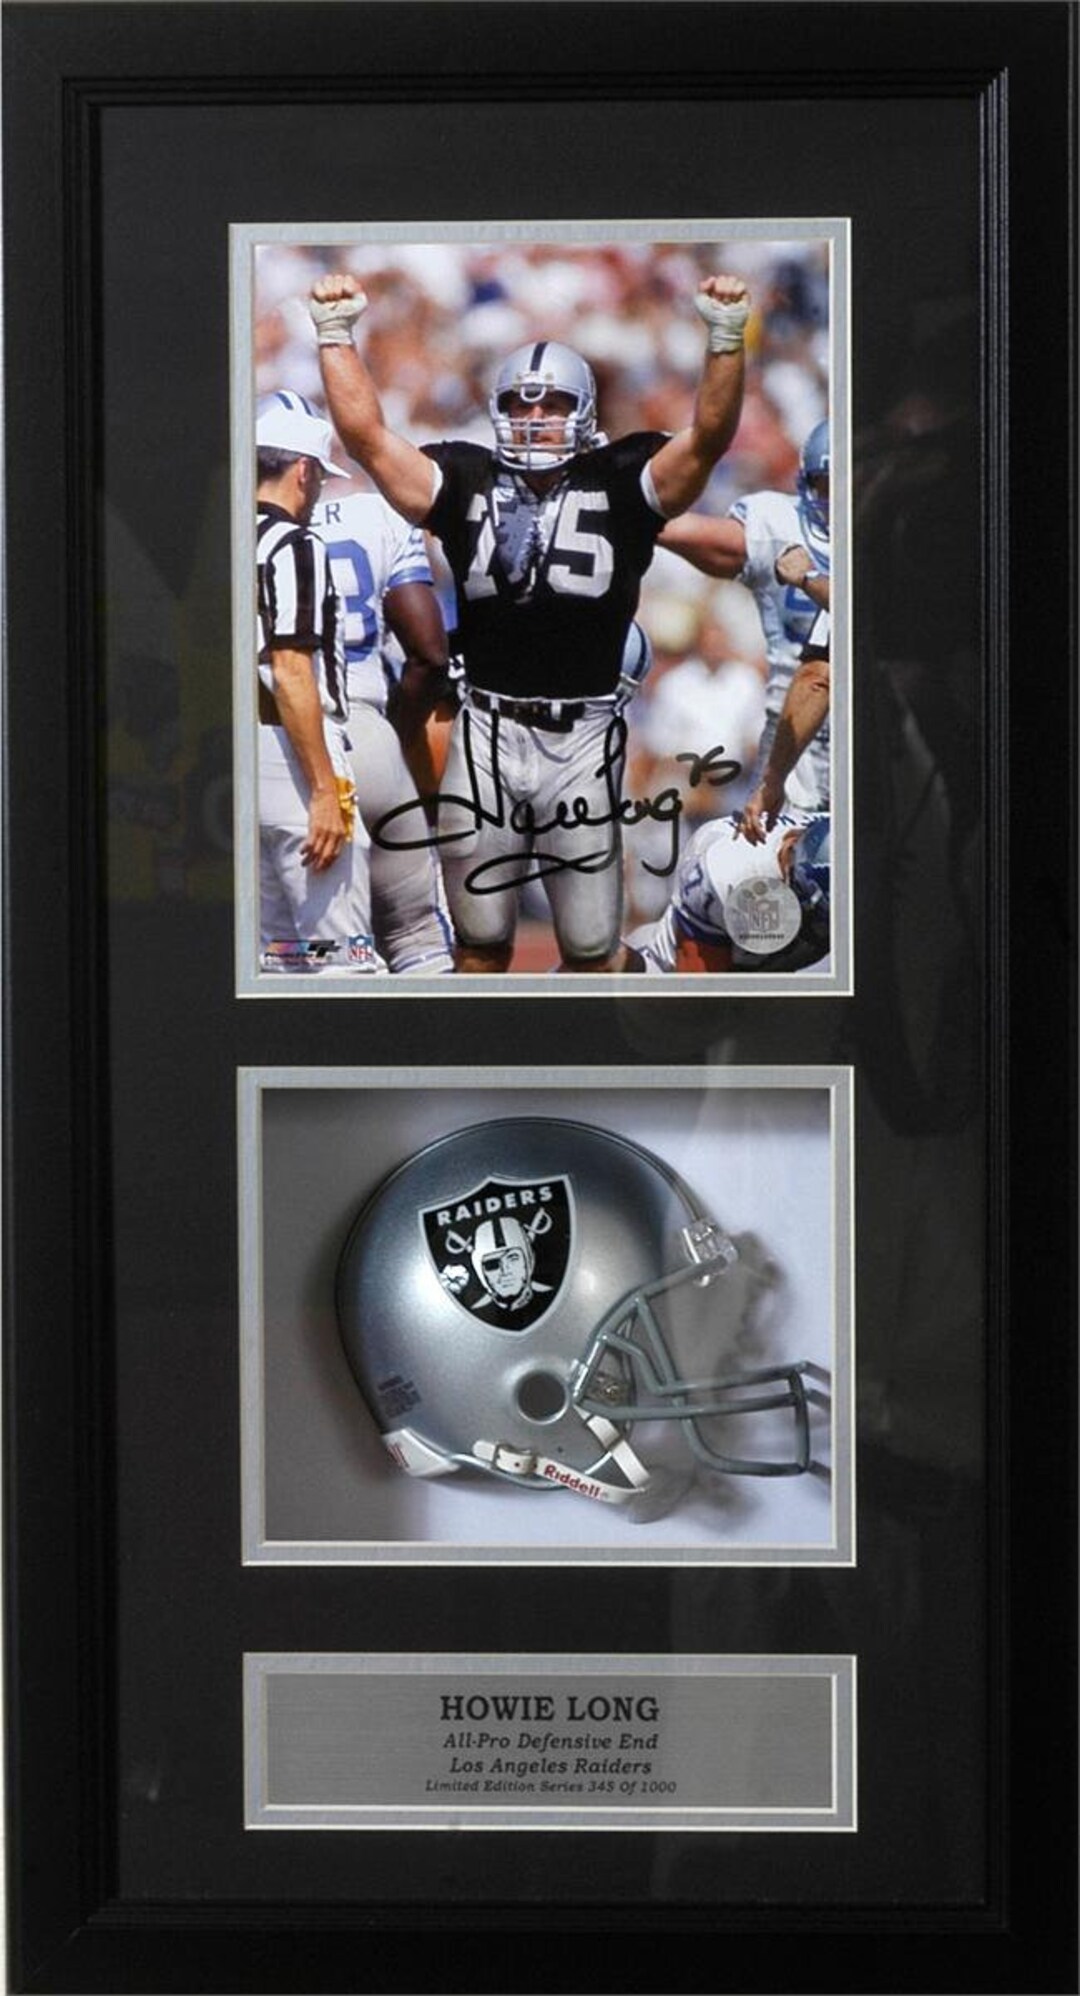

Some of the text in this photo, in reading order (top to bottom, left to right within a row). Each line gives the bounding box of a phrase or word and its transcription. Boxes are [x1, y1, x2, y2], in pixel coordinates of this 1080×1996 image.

[436, 1186, 553, 1226] RAIDERS
[544, 1464, 601, 1498] Riddell
[440, 1695, 660, 1722] HOWIE LONG
[443, 1732, 659, 1752] All-Pro Defensive End
[449, 1757, 652, 1777] Los Angeles Raiders
[425, 1780, 479, 1792] Limited
[483, 1780, 535, 1792] Edition
[539, 1780, 583, 1792] Series
[587, 1780, 615, 1792] 345
[640, 1781, 677, 1793] 1000
